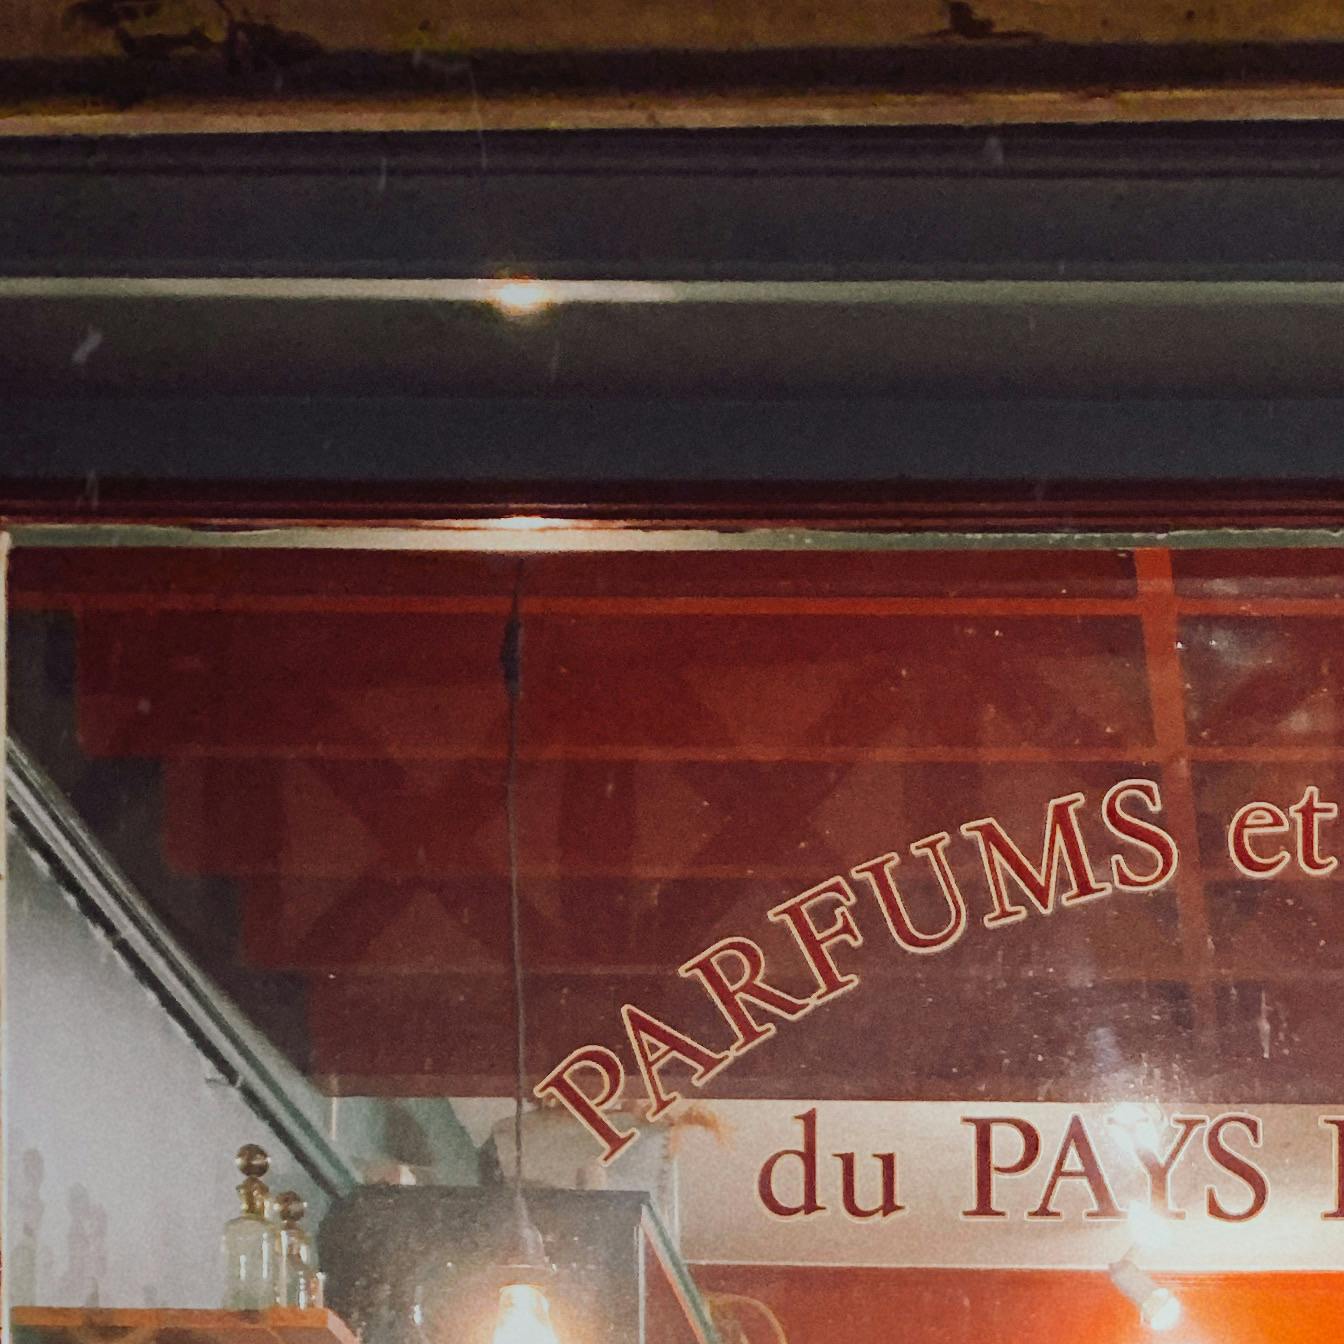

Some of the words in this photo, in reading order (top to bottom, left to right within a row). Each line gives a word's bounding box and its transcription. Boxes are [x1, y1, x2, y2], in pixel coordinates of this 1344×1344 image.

[532, 778, 1180, 1167] PARFUMS
[1228, 785, 1339, 877] et
[756, 1107, 906, 1223] du
[960, 1113, 1271, 1223] PAYS
